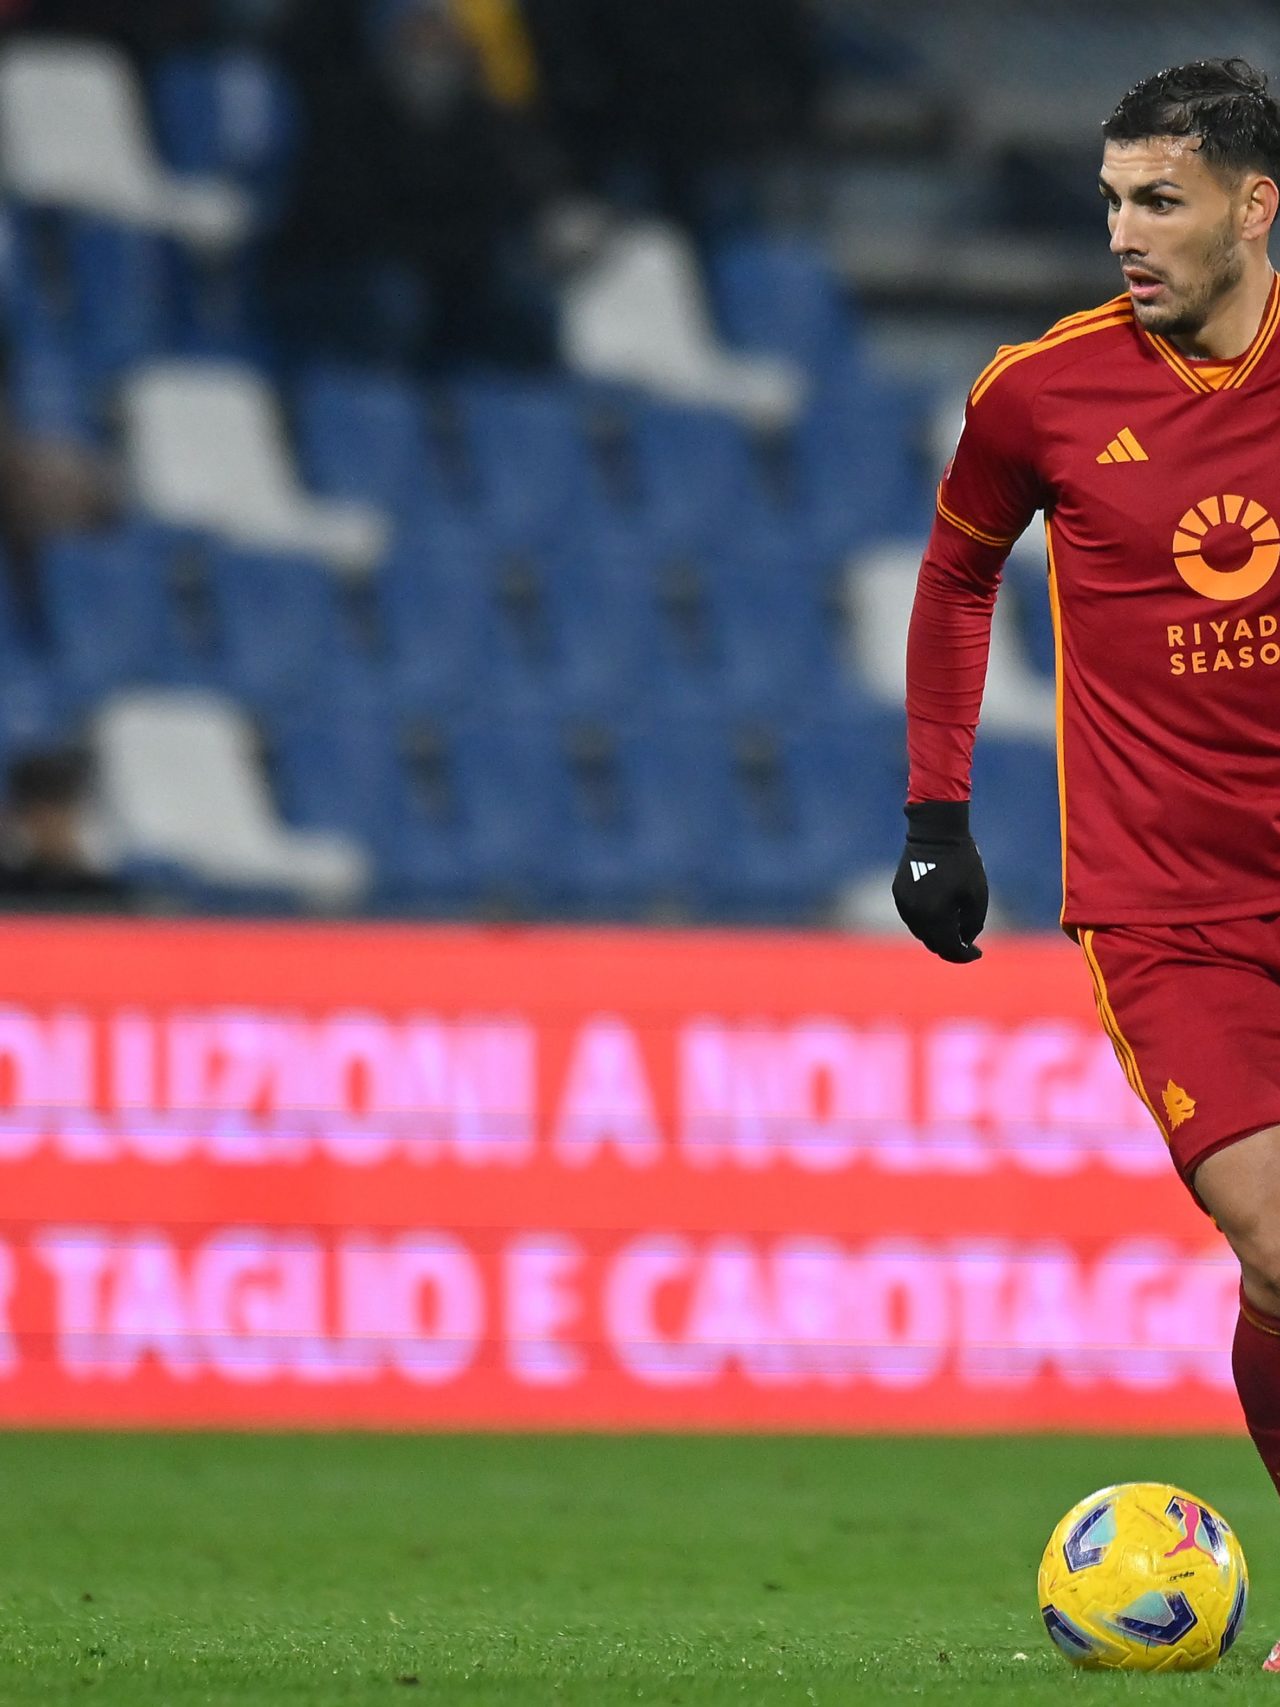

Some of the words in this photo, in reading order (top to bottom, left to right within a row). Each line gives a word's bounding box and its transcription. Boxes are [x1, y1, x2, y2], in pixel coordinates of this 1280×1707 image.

[555, 1012, 663, 1166] A
[34, 1226, 485, 1382] TAGLIO
[508, 1230, 583, 1384] E
